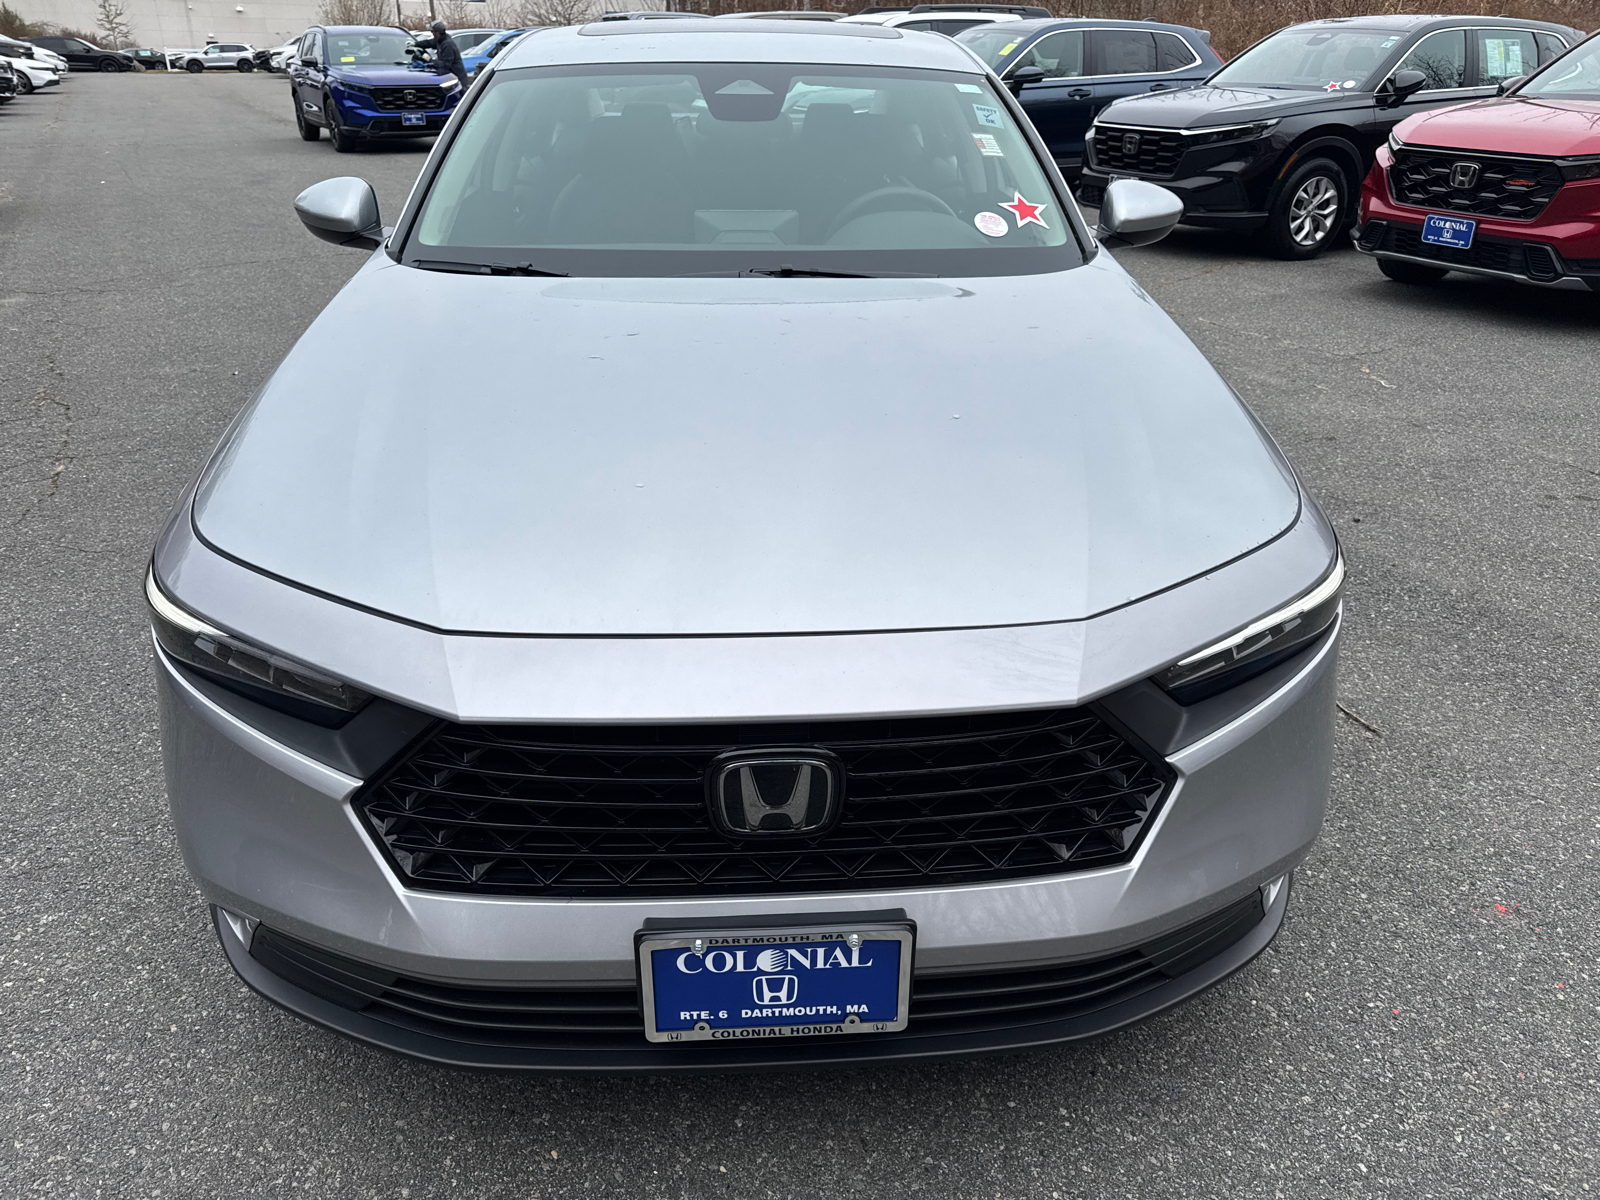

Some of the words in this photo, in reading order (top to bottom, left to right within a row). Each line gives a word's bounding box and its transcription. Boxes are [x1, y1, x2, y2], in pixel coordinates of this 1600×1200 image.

[976, 106, 997, 114] SAFETY
[1430, 220, 1468, 231] COLONIAL
[708, 935, 815, 945] DARTMOUTH,
[676, 946, 873, 974] COLONIAL
[680, 1010, 715, 1020] RTE.
[718, 1010, 728, 1019] 6
[741, 1005, 842, 1018] DARTMOUTH,
[846, 1004, 869, 1013] MA
[711, 1027, 786, 1039] COLONIAL
[790, 1025, 844, 1035] HONDA
